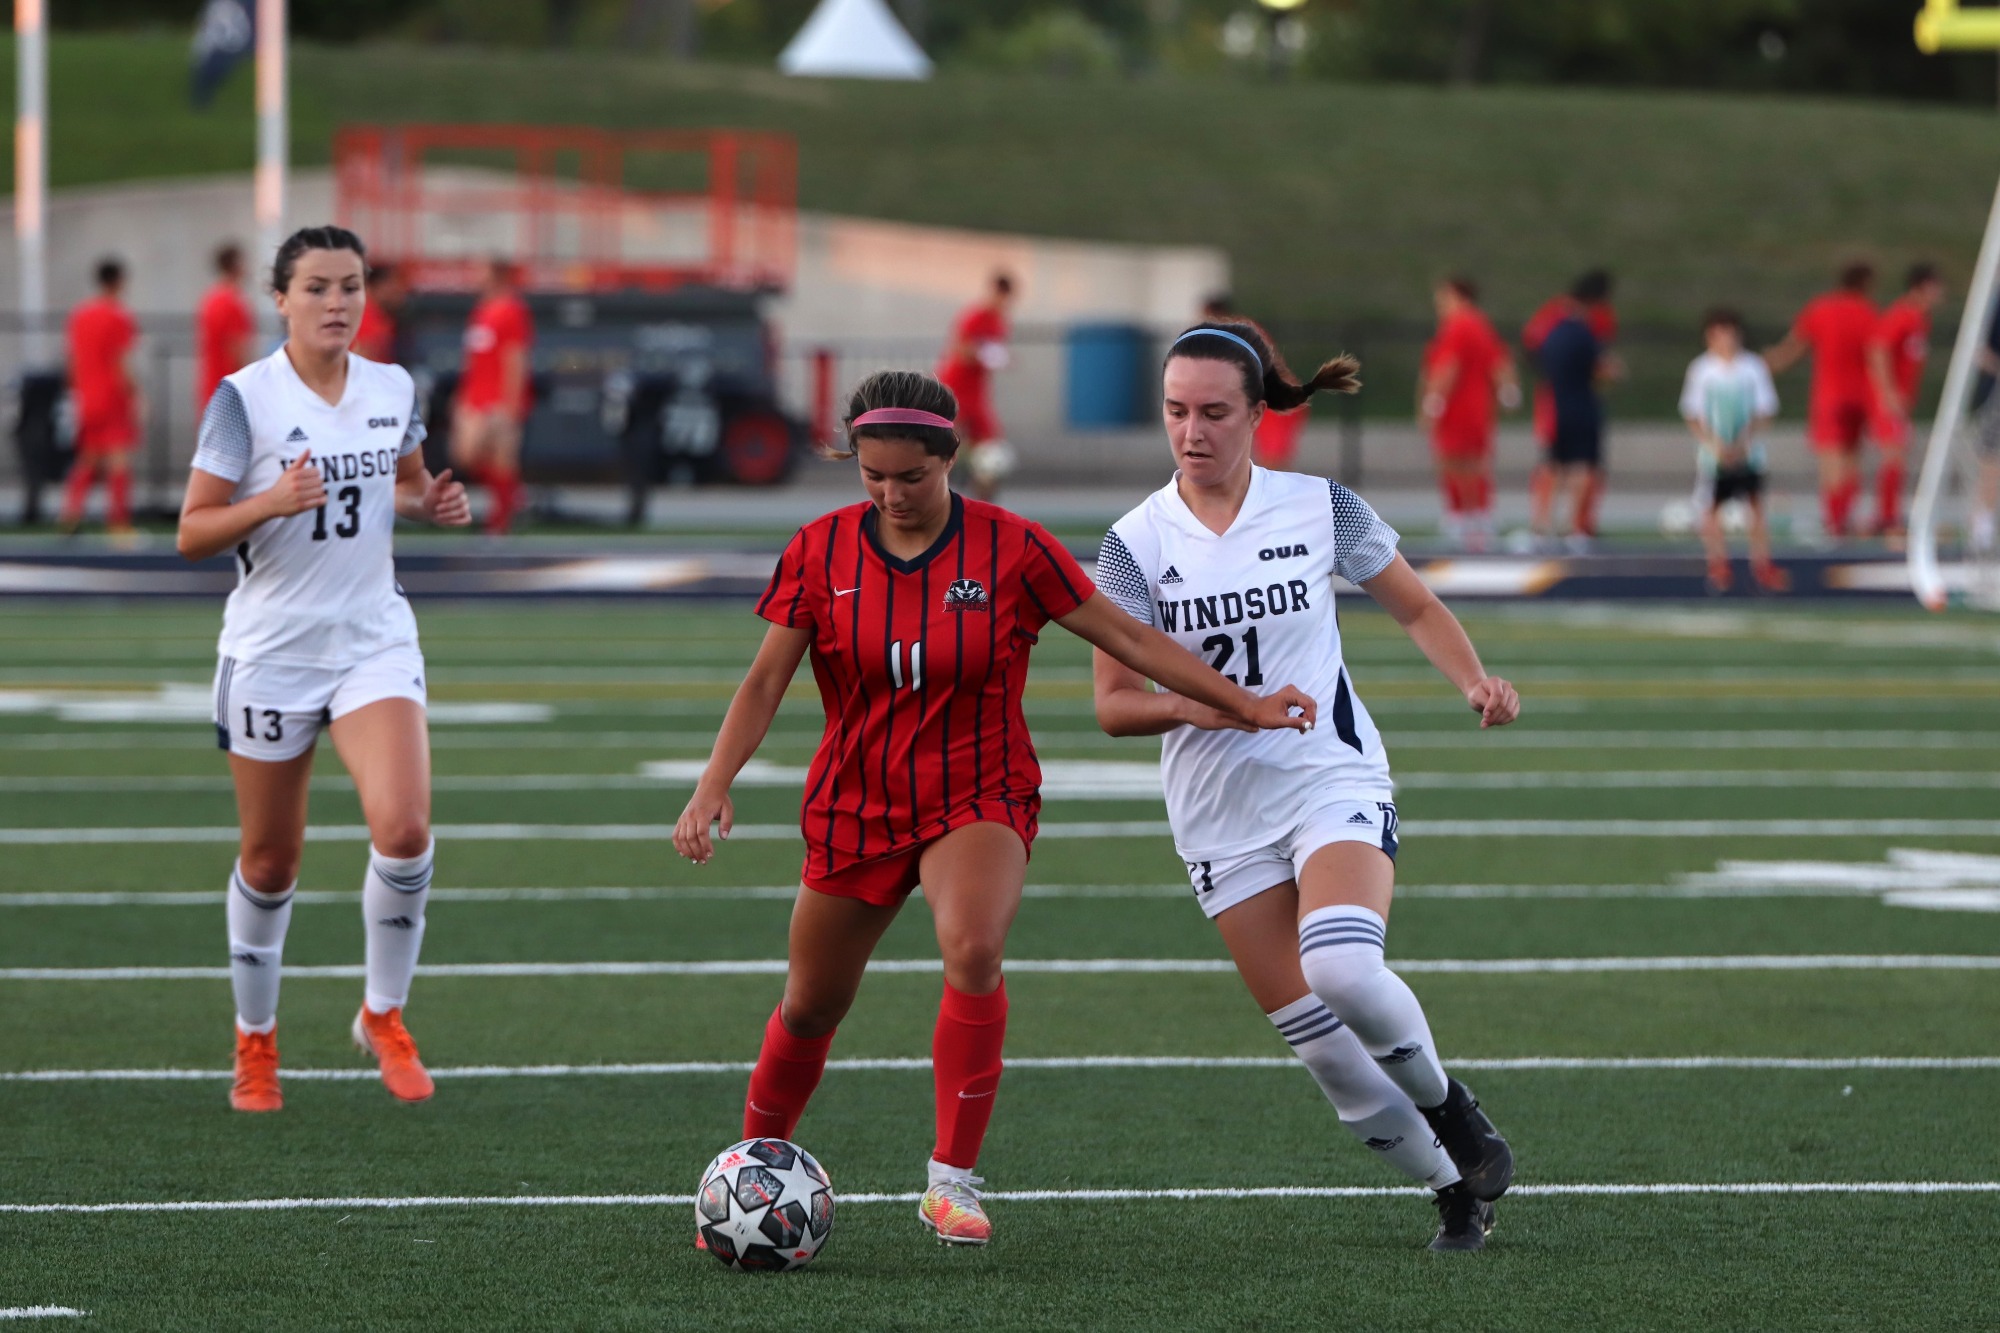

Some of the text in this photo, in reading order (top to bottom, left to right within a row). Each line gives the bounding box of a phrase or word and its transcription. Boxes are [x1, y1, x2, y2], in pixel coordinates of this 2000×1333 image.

[368, 417, 400, 428] OUA
[312, 485, 362, 541] 13
[1258, 544, 1309, 561] OUA
[1158, 576, 1183, 585] adidas
[1158, 580, 1310, 633] WINDSOR
[890, 639, 922, 692] 11
[1202, 626, 1263, 687] 21
[243, 705, 283, 742] 13
[719, 1158, 746, 1172] adidas
